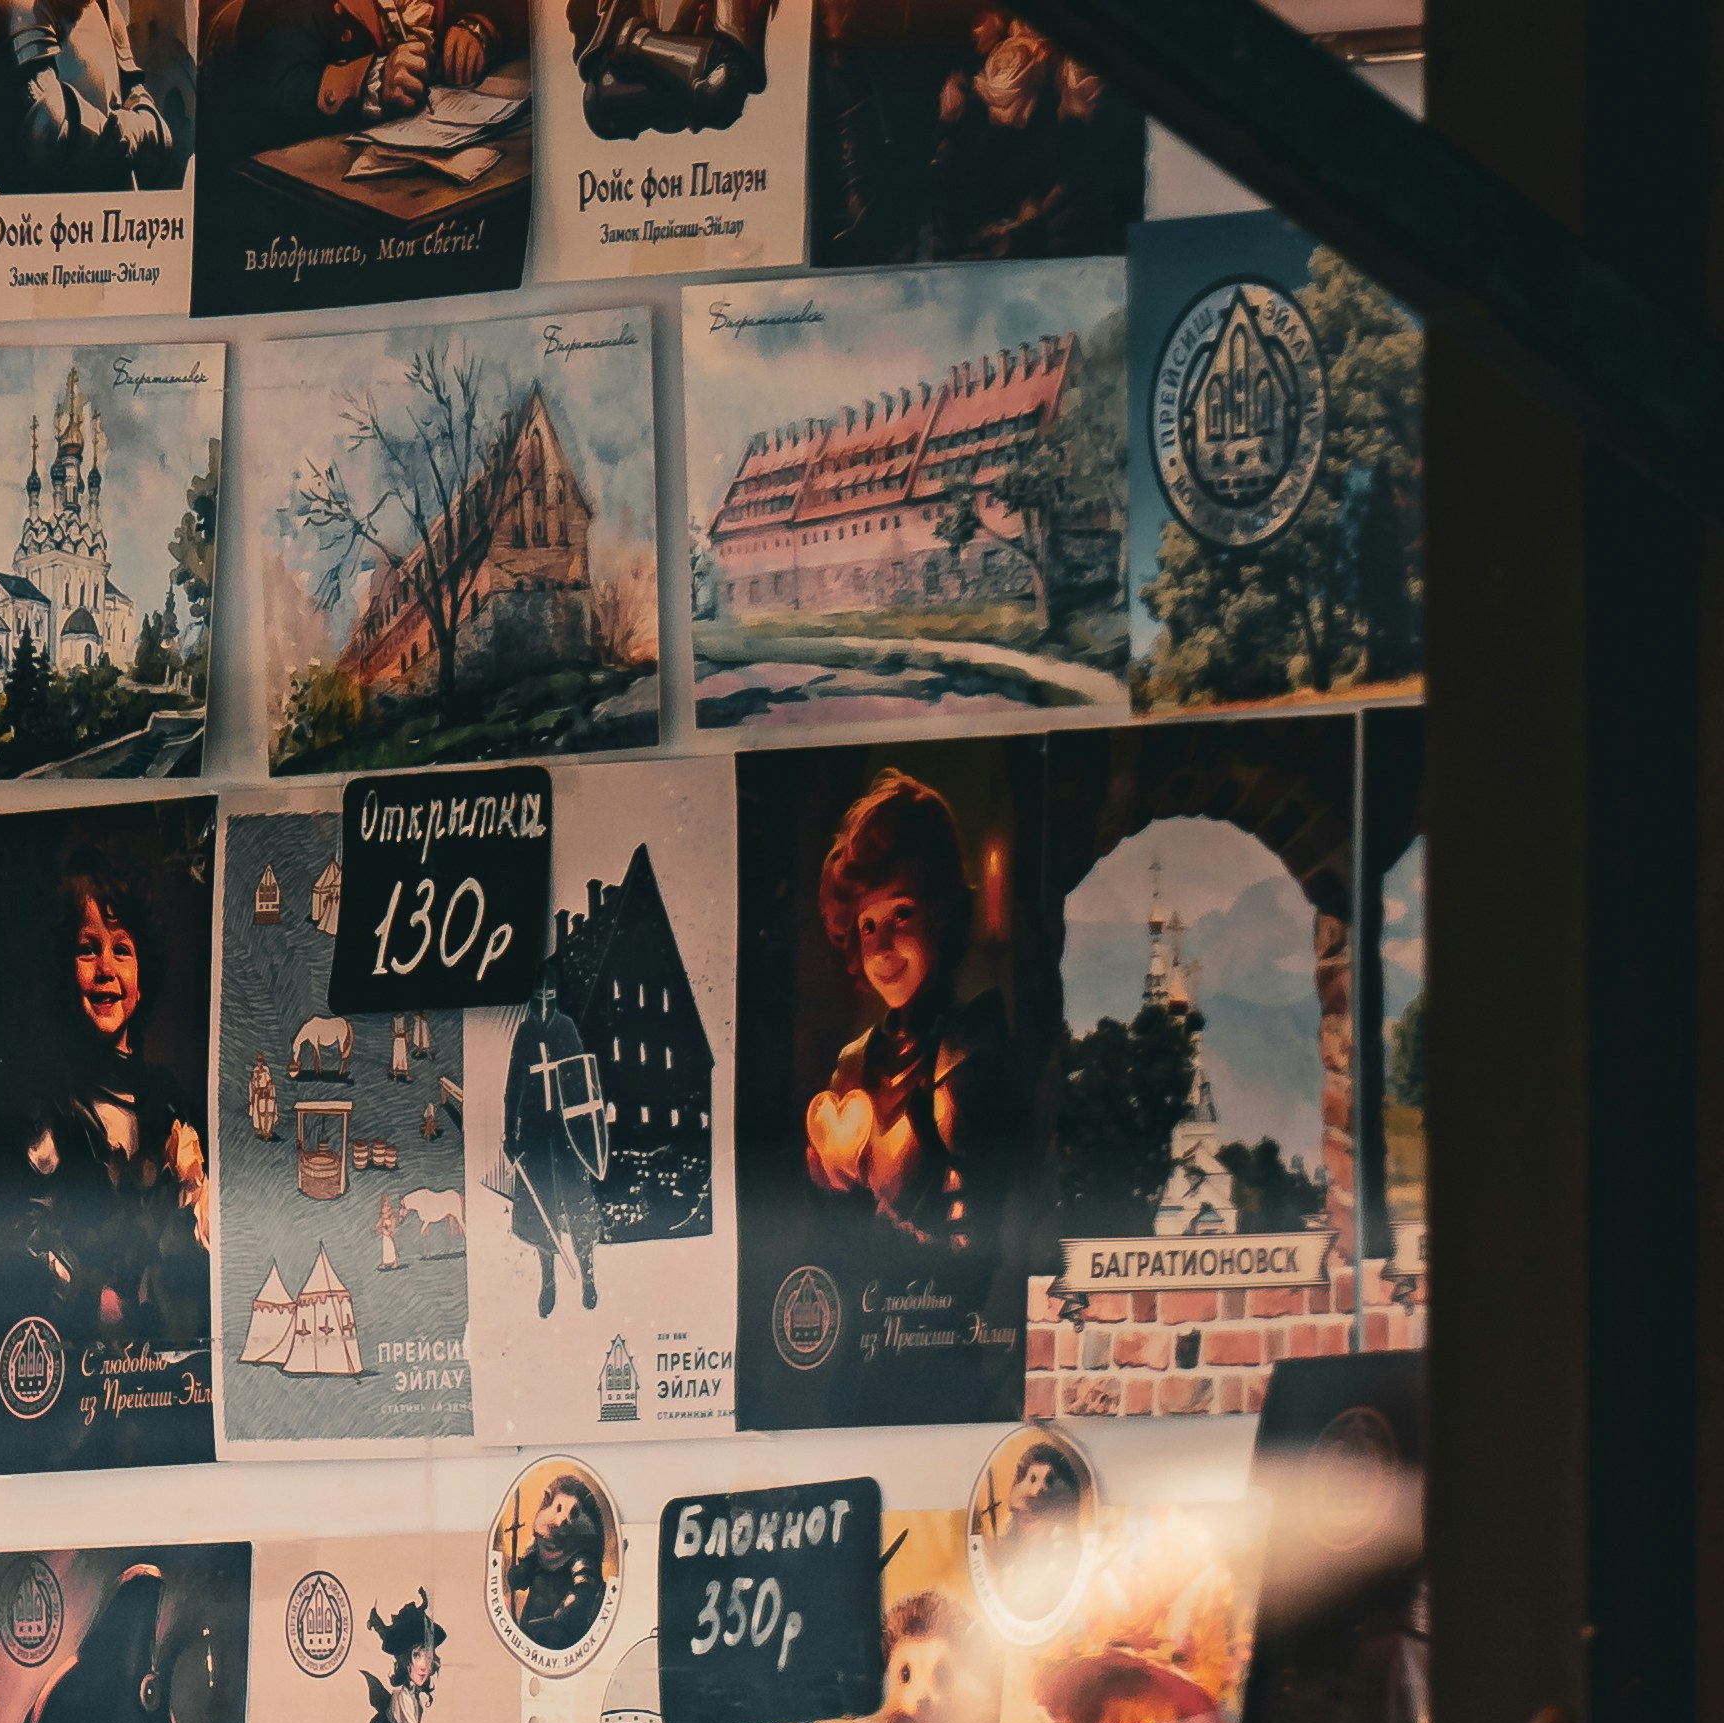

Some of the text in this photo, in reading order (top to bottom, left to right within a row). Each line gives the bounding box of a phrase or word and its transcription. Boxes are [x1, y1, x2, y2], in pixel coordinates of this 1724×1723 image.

[578, 161, 767, 212] Ройс фон Плауэн
[50, 212, 93, 253] фон
[101, 209, 185, 250] Плауэн
[600, 215, 745, 245] Замок Прейсиш-Эйлау
[244, 218, 486, 283] Взбодритесь, Mon Chérie!
[8, 263, 160, 289] Замок Прейсиш-Эйлау
[1160, 305, 1220, 449] ПРЕЙСИШ
[360, 789, 547, 864] Открытка
[1090, 1246, 1302, 1278] БАГРАТИОНОВСК
[881, 1279, 953, 1312] любовью
[100, 1342, 168, 1376] любовью
[395, 1366, 464, 1391] ЭЙЛАУ
[657, 1375, 721, 1399] ЭЙЛАУ
[80, 1395, 96, 1426] из
[673, 1499, 851, 1558] Блокнот
